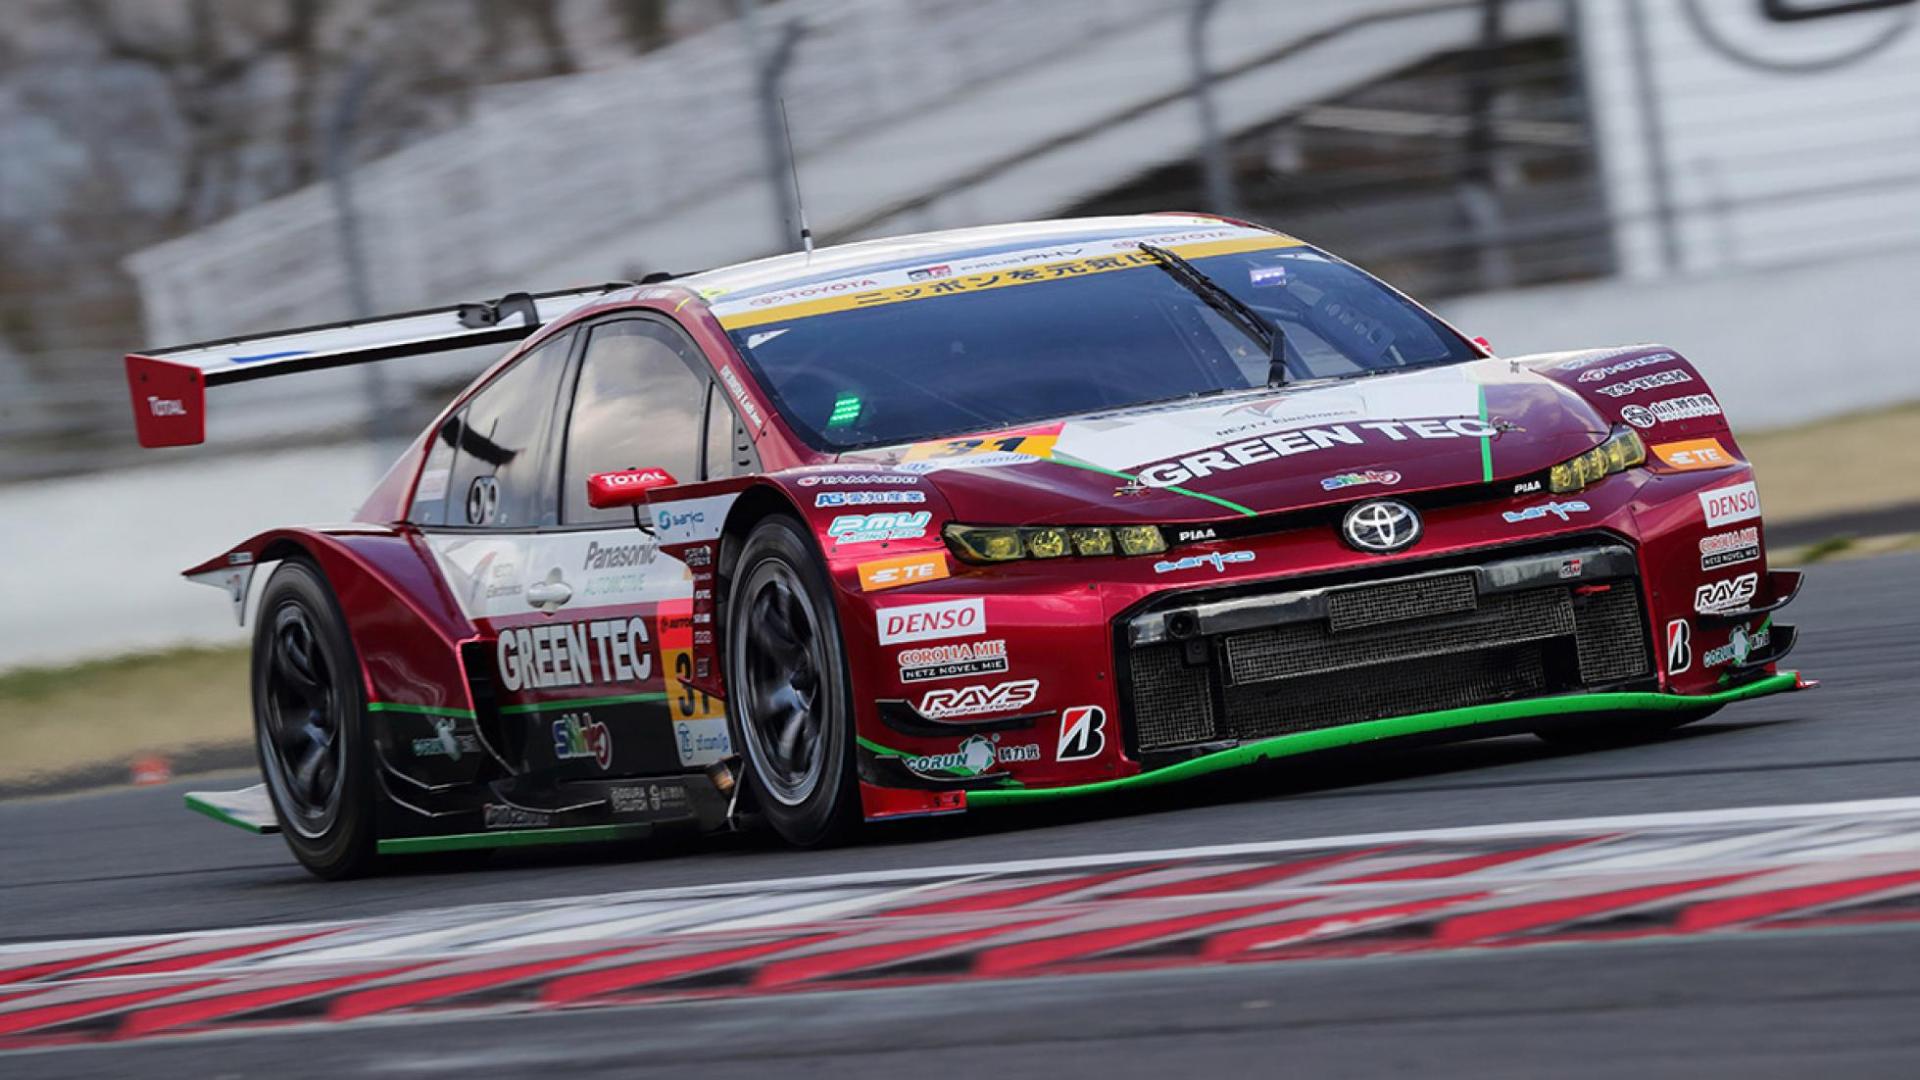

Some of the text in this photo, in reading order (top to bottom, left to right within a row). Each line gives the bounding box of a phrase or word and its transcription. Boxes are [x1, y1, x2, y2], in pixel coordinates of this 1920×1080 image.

[1021, 248, 1083, 262] PHV
[783, 278, 878, 303] TOYOTA
[147, 397, 187, 416] TOTAL
[929, 437, 1026, 458] 31
[1139, 417, 1499, 488] GREEN TEC
[601, 471, 667, 487] TOTAL
[1514, 480, 1541, 494] PIAA
[1709, 491, 1757, 518] DENSO
[1179, 528, 1216, 541] PIAA
[584, 541, 657, 571] Panasonic
[904, 563, 935, 578] TE
[1696, 576, 1756, 607] RAYS
[887, 607, 976, 636] DENSO
[497, 616, 651, 692] GREEN TEC
[900, 640, 1006, 665] COROLLA MIE
[906, 660, 1003, 679] NETZ NOVEL MIE
[922, 681, 1037, 714] RAYS
[907, 754, 968, 770] CORUN
